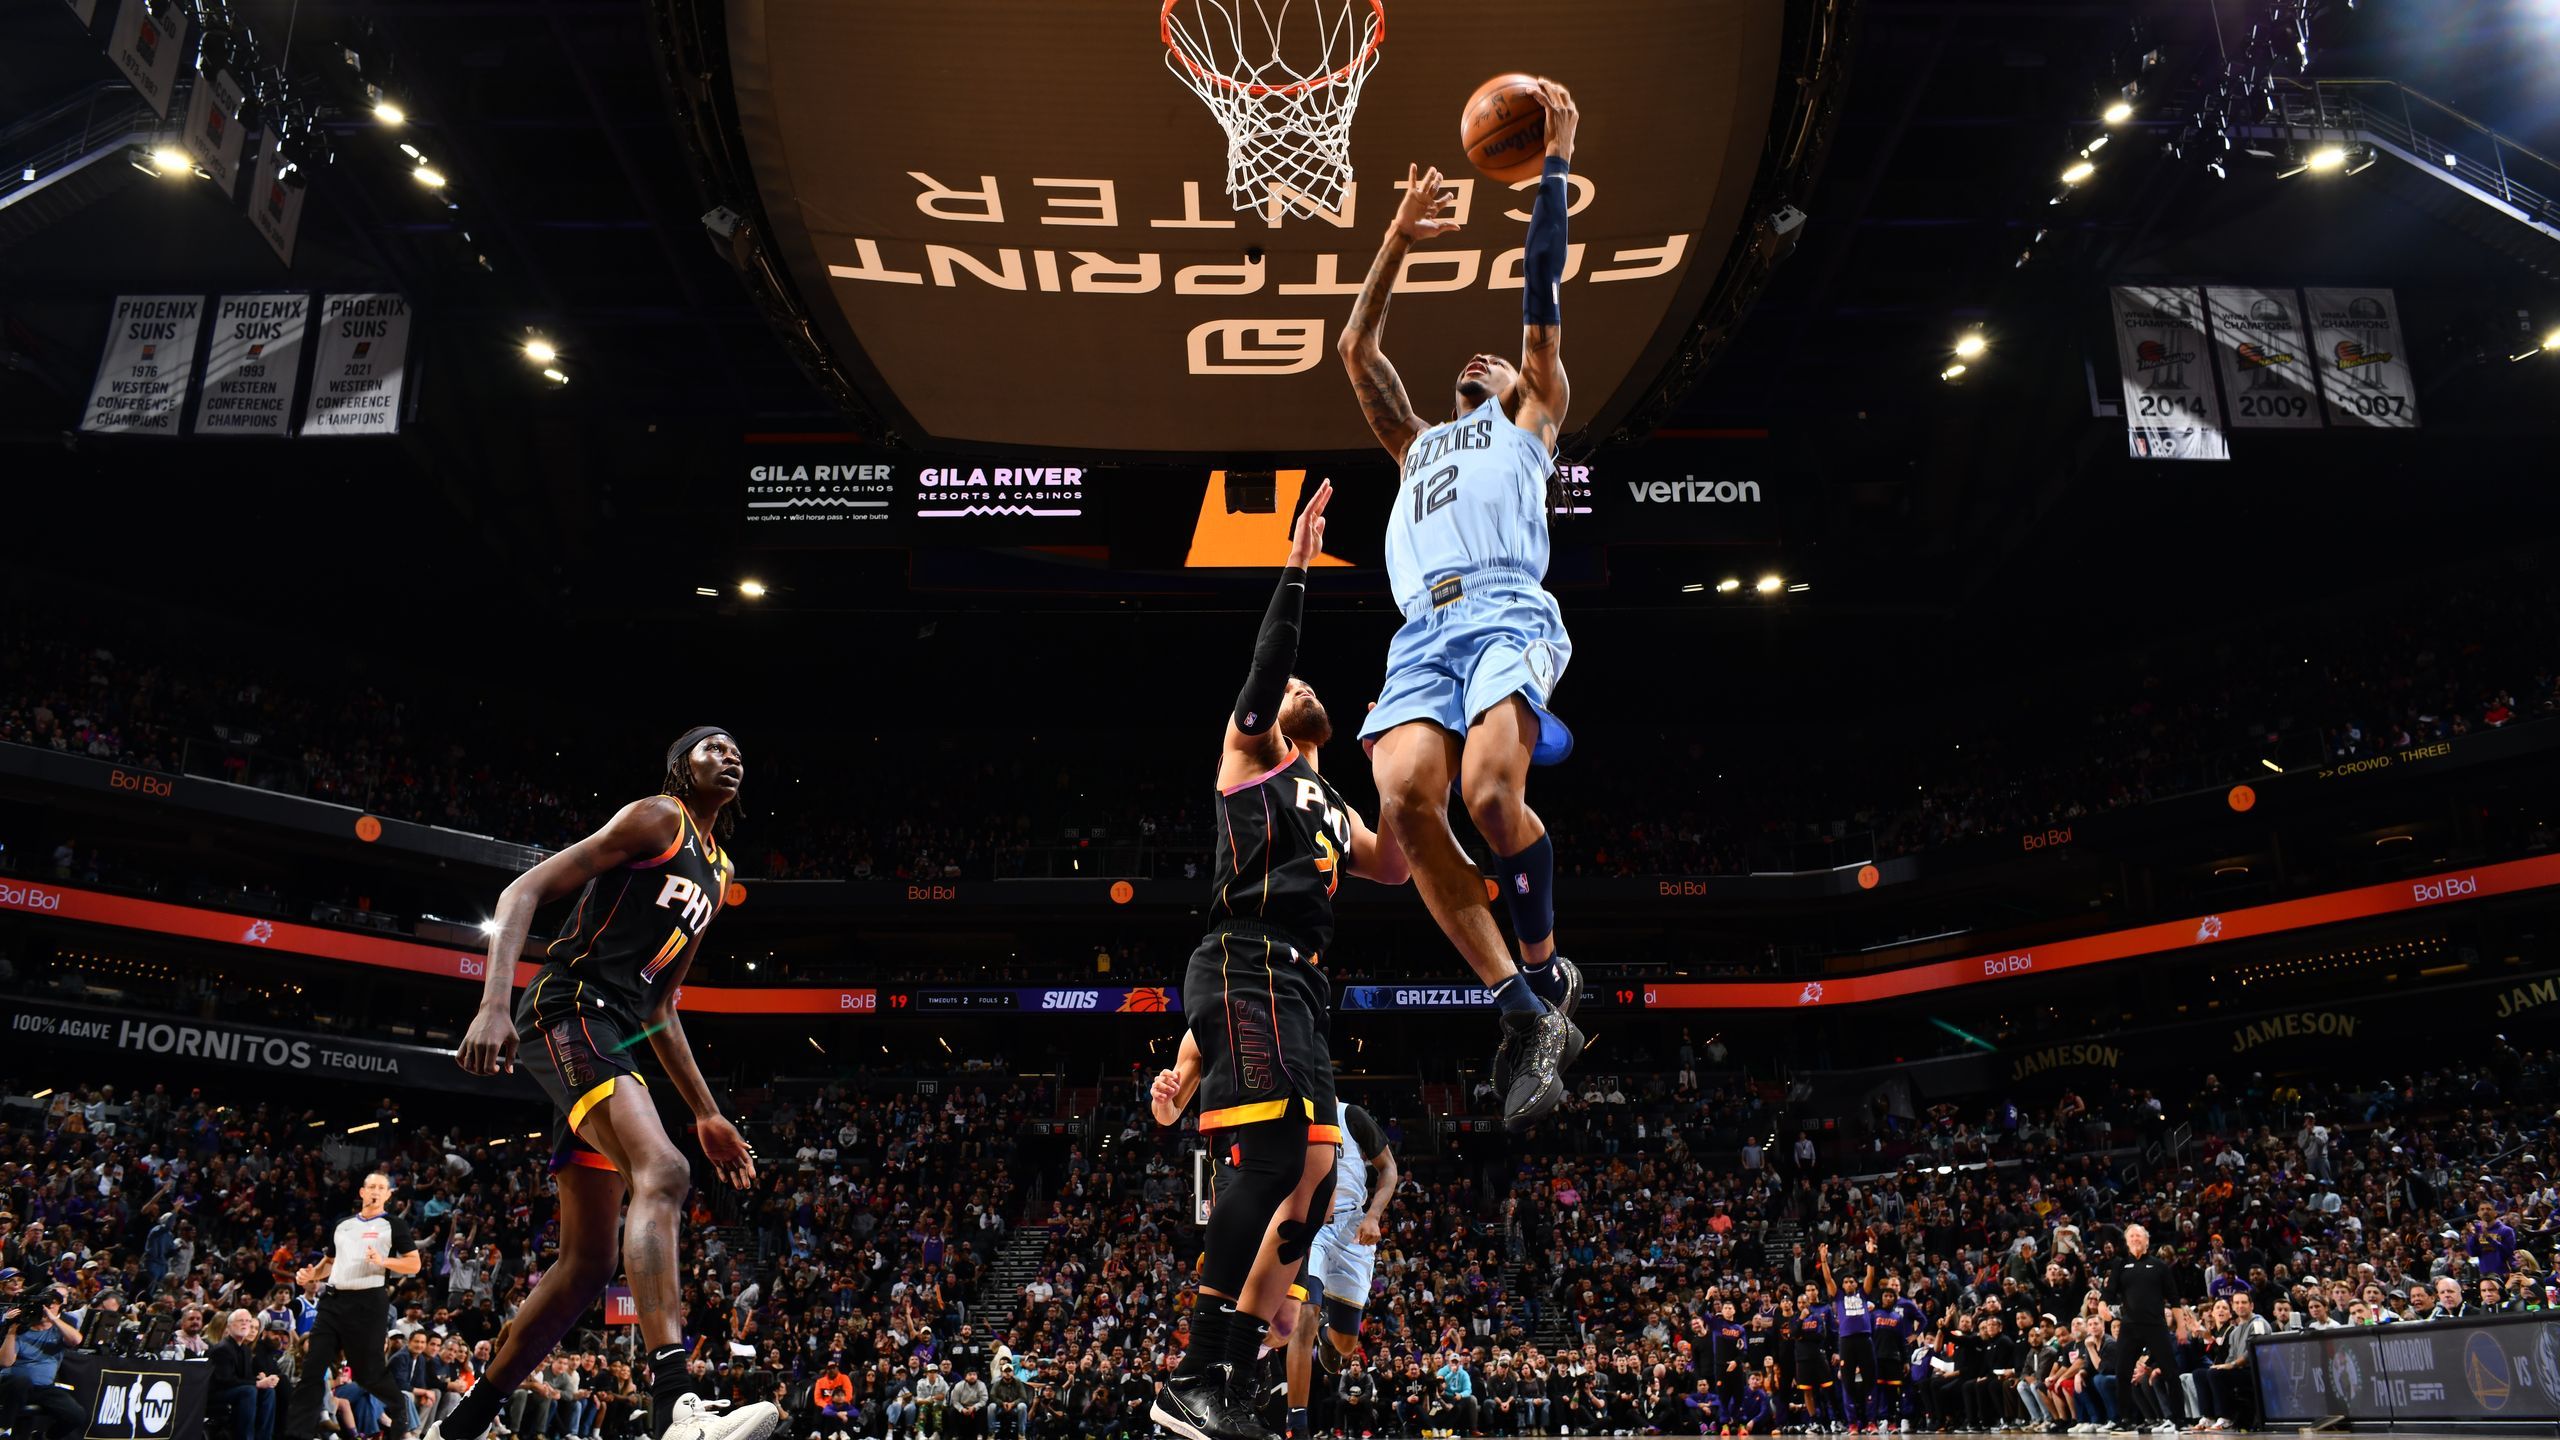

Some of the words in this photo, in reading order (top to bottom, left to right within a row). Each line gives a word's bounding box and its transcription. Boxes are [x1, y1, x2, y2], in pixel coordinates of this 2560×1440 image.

[906, 171, 1596, 230] CENTER
[828, 233, 1689, 296] FOOTPRINT
[118, 302, 197, 319] PHOENIX
[222, 302, 301, 319] PHOENIX
[330, 300, 405, 317] PHOENIX
[128, 323, 177, 340] SUNS
[233, 322, 282, 339] SUNS
[341, 320, 388, 338] SUNS
[2124, 319, 2194, 330] CHAMPIONS
[2223, 320, 2293, 331] CHAMPIONS
[2321, 319, 2391, 330] CHAMPIONS
[131, 365, 158, 378] 1976
[238, 365, 266, 378] 1993
[344, 364, 372, 376] 2021
[111, 381, 169, 394] WESTERN
[220, 381, 277, 394] WESTERN
[329, 379, 383, 393] WESTERN
[96, 397, 175, 411] CONFERENCE
[207, 398, 283, 411] CONFERENCE
[315, 396, 391, 409] CONFERENCE
[2138, 395, 2208, 418] 2014
[2239, 395, 2308, 418] 2009
[96, 413, 169, 428] CHAMPIONS
[206, 414, 278, 428] CHAMPIONS
[317, 413, 385, 425] CHAMPIONS
[750, 465, 808, 481] GILA
[814, 465, 890, 481] RIVER
[919, 468, 988, 487] GILA
[994, 467, 1082, 486] RIVER
[748, 485, 812, 493] RESORTS
[818, 485, 827, 493] &
[918, 492, 990, 500] RESORTS
[999, 492, 1007, 500] &
[1014, 491, 1083, 499] CASINOS
[1413, 464, 1459, 525] 12
[1628, 475, 1761, 503] verizon
[2337, 756, 2394, 776] CROWD:
[2400, 743, 2451, 763] THREE!
[110, 768, 141, 791] Bol
[142, 775, 173, 797] Bol
[2023, 833, 2047, 851] Bol
[2048, 827, 2072, 846] Bol
[0, 884, 27, 905] Bol
[28, 889, 60, 910] Bol
[908, 886, 930, 900] Bol
[933, 885, 955, 900] Bol
[1660, 881, 1681, 896] Bol
[1684, 881, 1706, 896] Bol
[2413, 880, 2444, 902] Bol
[2446, 875, 2477, 897] Bol
[640, 926, 689, 984] 11
[460, 957, 483, 976] Bol
[1984, 958, 2007, 976] Bol
[2009, 953, 2032, 971] Bol
[841, 994, 864, 1008] Bol
[889, 995, 909, 1008] 19
[1041, 990, 1099, 1010] SUNS
[1396, 989, 1494, 1005] GRIZZLIES
[1616, 990, 1634, 1004] 19
[2232, 1012, 2355, 1053] JAMESON
[12, 1013, 55, 1034] 100%
[59, 1018, 112, 1041] AGAVE
[118, 1020, 312, 1069] HORNITOS
[320, 1049, 399, 1074] TEQUILA
[2011, 1043, 2121, 1081] JAMESON
[2369, 1338, 2434, 1373] TOMORROW
[2513, 1356, 2533, 1387] VS
[98, 1385, 126, 1425] NBA
